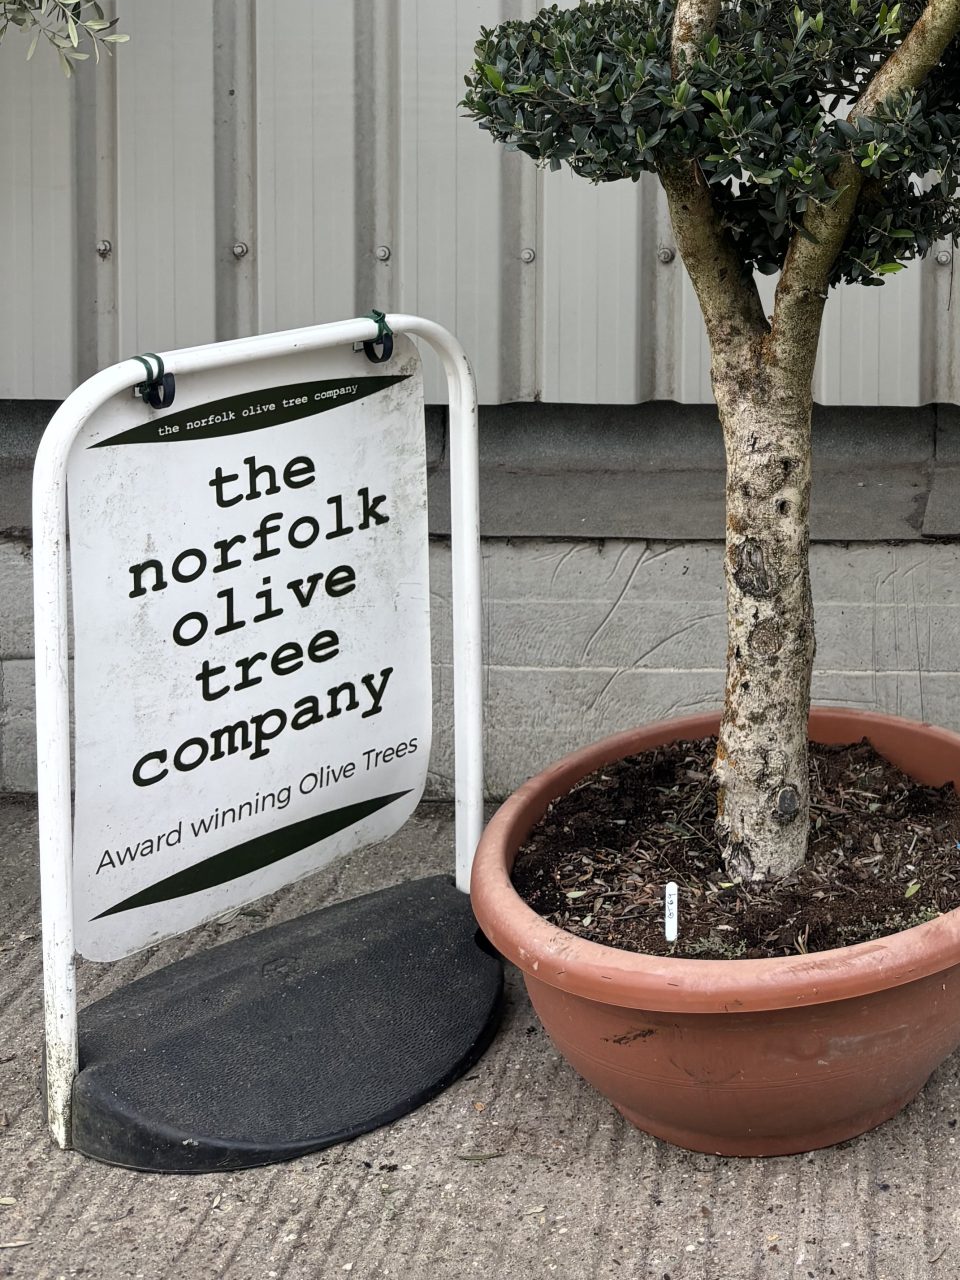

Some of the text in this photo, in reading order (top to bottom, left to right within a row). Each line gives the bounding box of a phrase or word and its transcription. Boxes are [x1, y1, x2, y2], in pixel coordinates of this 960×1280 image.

[157, 384, 359, 436] the norfolk olive tree company
[208, 455, 316, 508] the
[128, 486, 390, 599] norfolk
[172, 564, 356, 647] olive
[195, 629, 340, 703] tree
[132, 666, 394, 787] company
[95, 737, 418, 876] Award winning Olive Trees
